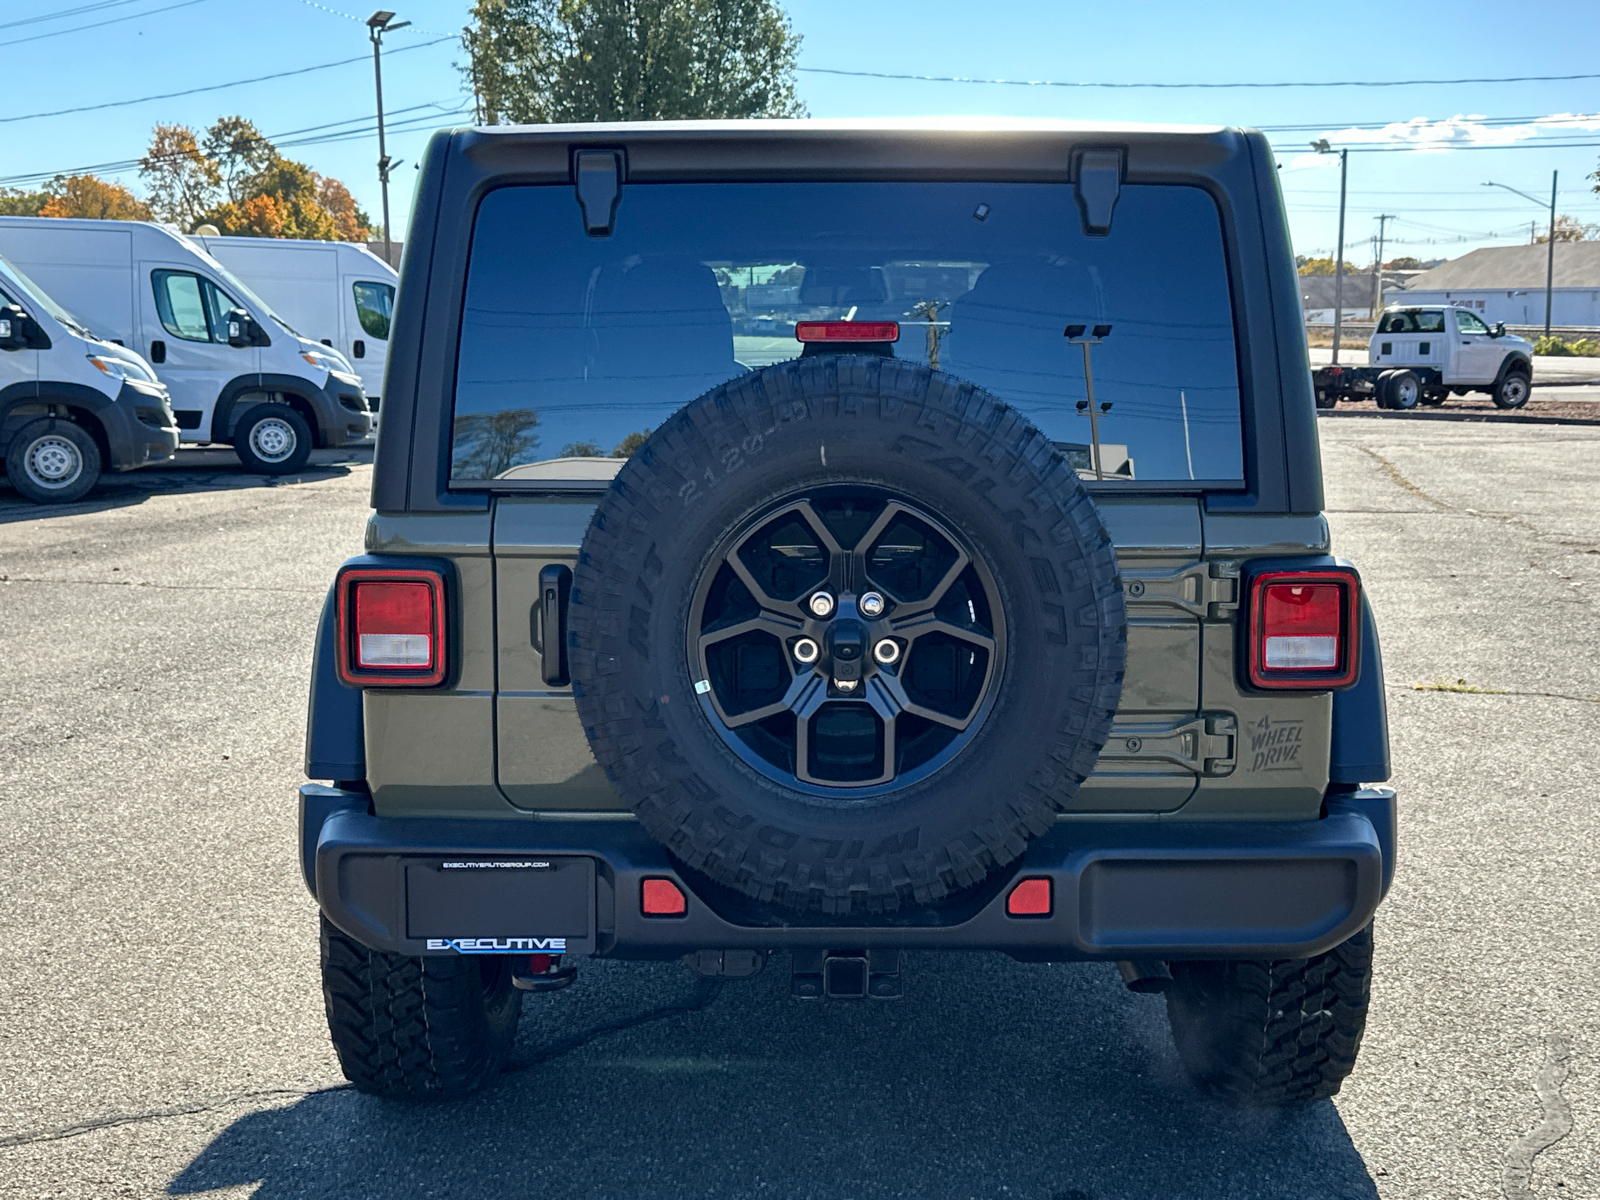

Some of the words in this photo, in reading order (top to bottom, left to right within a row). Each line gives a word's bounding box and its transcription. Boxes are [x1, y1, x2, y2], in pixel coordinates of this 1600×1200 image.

[890, 433, 1070, 648] FALKEN
[626, 541, 665, 660] M/T
[1257, 714, 1270, 730] 4
[1251, 727, 1303, 752] WHEEL
[1252, 744, 1301, 772] DRIVE
[629, 695, 923, 860] WILDPEAK
[426, 938, 566, 952] EXECUTIVE
